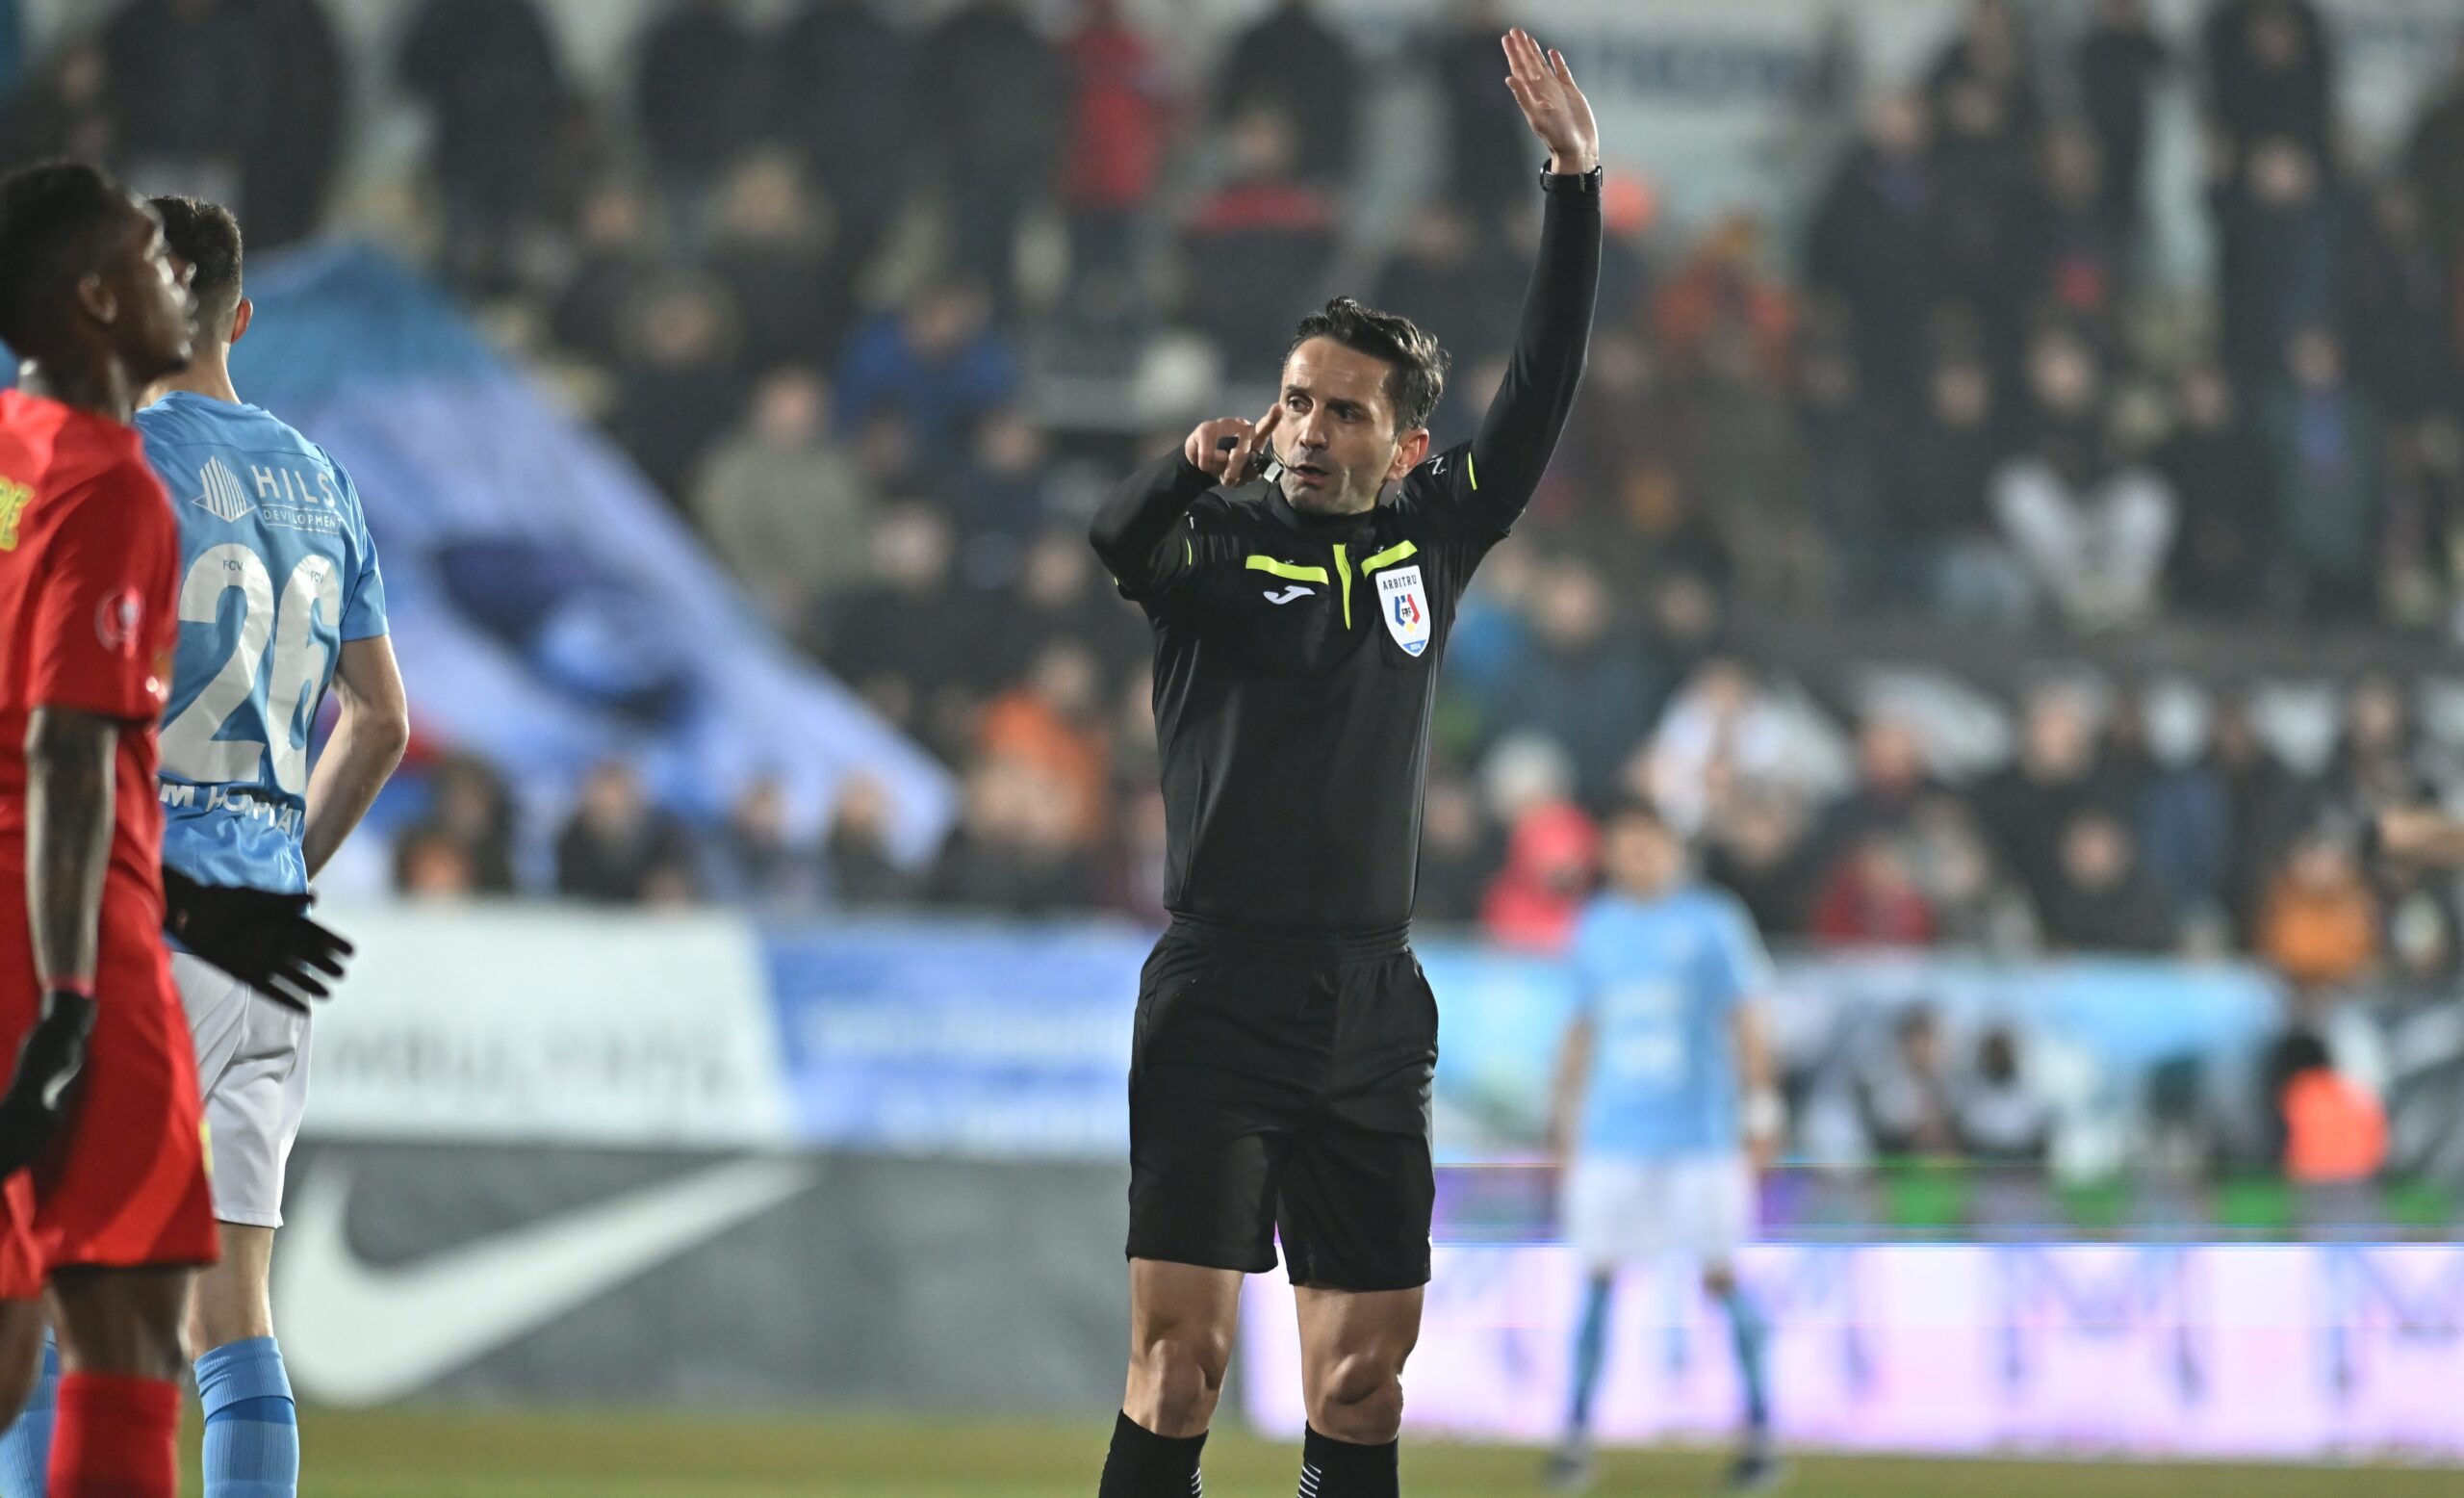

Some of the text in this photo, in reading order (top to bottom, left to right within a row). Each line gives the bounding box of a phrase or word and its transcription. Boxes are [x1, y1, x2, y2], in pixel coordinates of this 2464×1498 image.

[250, 465, 336, 508] HILS
[222, 558, 244, 572] FCV
[1382, 575, 1417, 590] ARBITRU
[158, 542, 341, 795] 26
